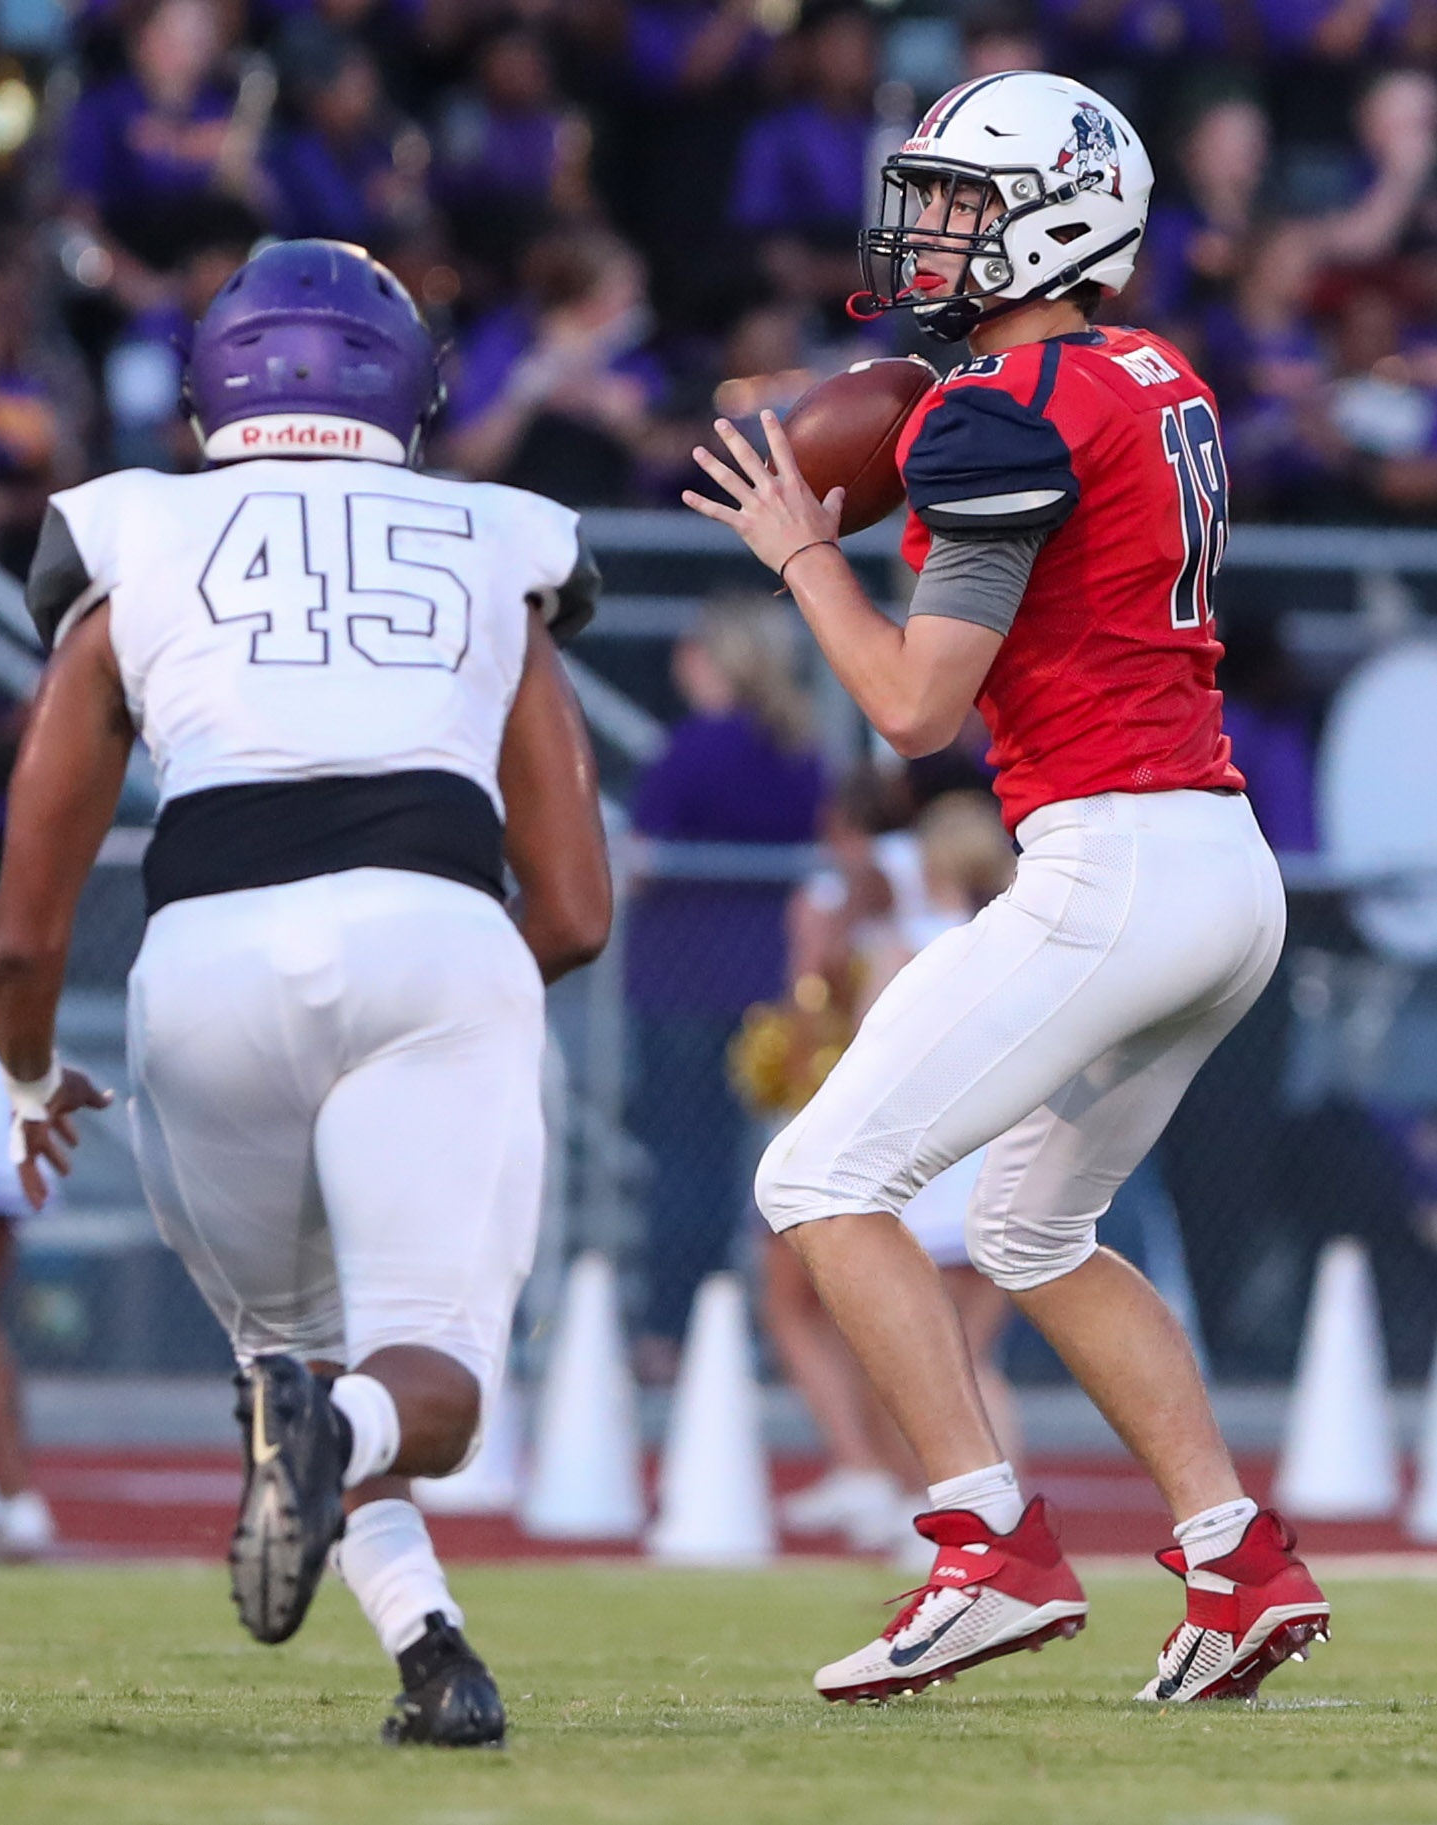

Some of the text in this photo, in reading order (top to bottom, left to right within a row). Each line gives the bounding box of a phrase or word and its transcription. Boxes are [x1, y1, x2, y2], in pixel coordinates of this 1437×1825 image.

[241, 424, 363, 450] Riddell
[1160, 395, 1232, 631] 18
[197, 491, 474, 674] 45
